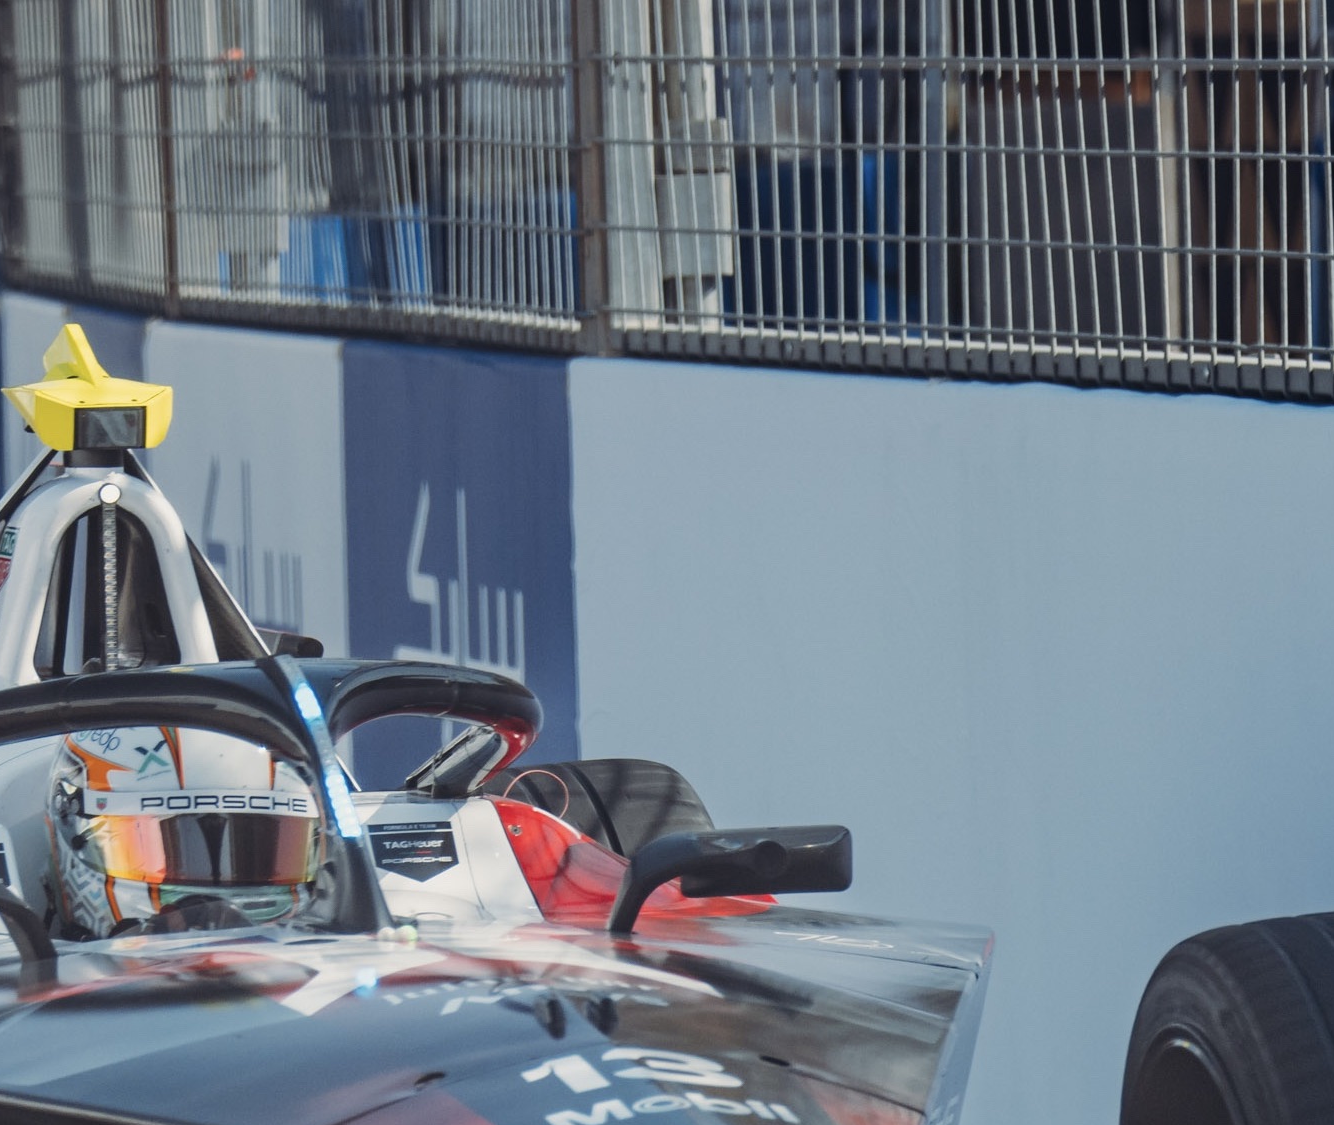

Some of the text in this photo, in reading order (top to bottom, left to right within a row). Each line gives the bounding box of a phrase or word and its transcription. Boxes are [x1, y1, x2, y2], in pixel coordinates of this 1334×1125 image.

[140, 794, 308, 813] PORSCHE
[382, 856, 453, 865] PORSCHE
[520, 1047, 744, 1094] 13
